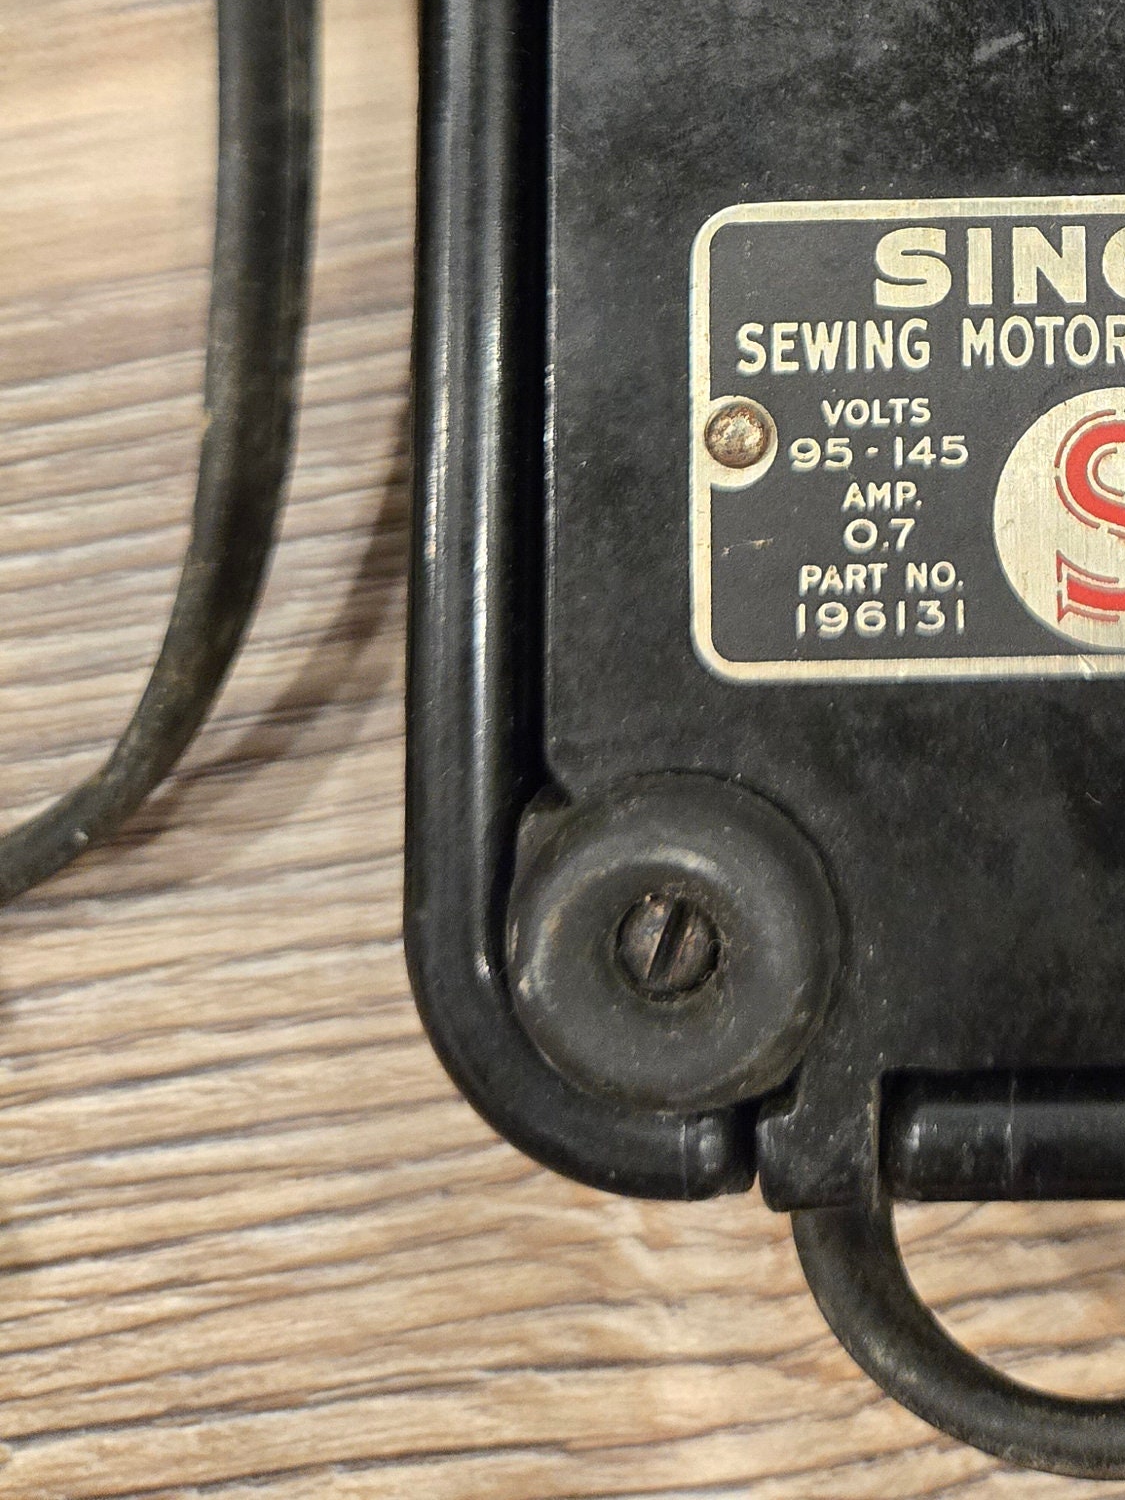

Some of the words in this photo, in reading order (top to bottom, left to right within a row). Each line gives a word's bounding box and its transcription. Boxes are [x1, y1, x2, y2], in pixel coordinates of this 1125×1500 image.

[736, 317, 931, 374] SEWING
[821, 397, 932, 428] VOLTS
[841, 481, 922, 512] AMP.
[843, 518, 916, 554] 0.7
[798, 562, 888, 597] PART
[905, 560, 964, 593] NO.
[795, 599, 965, 640] 196131
